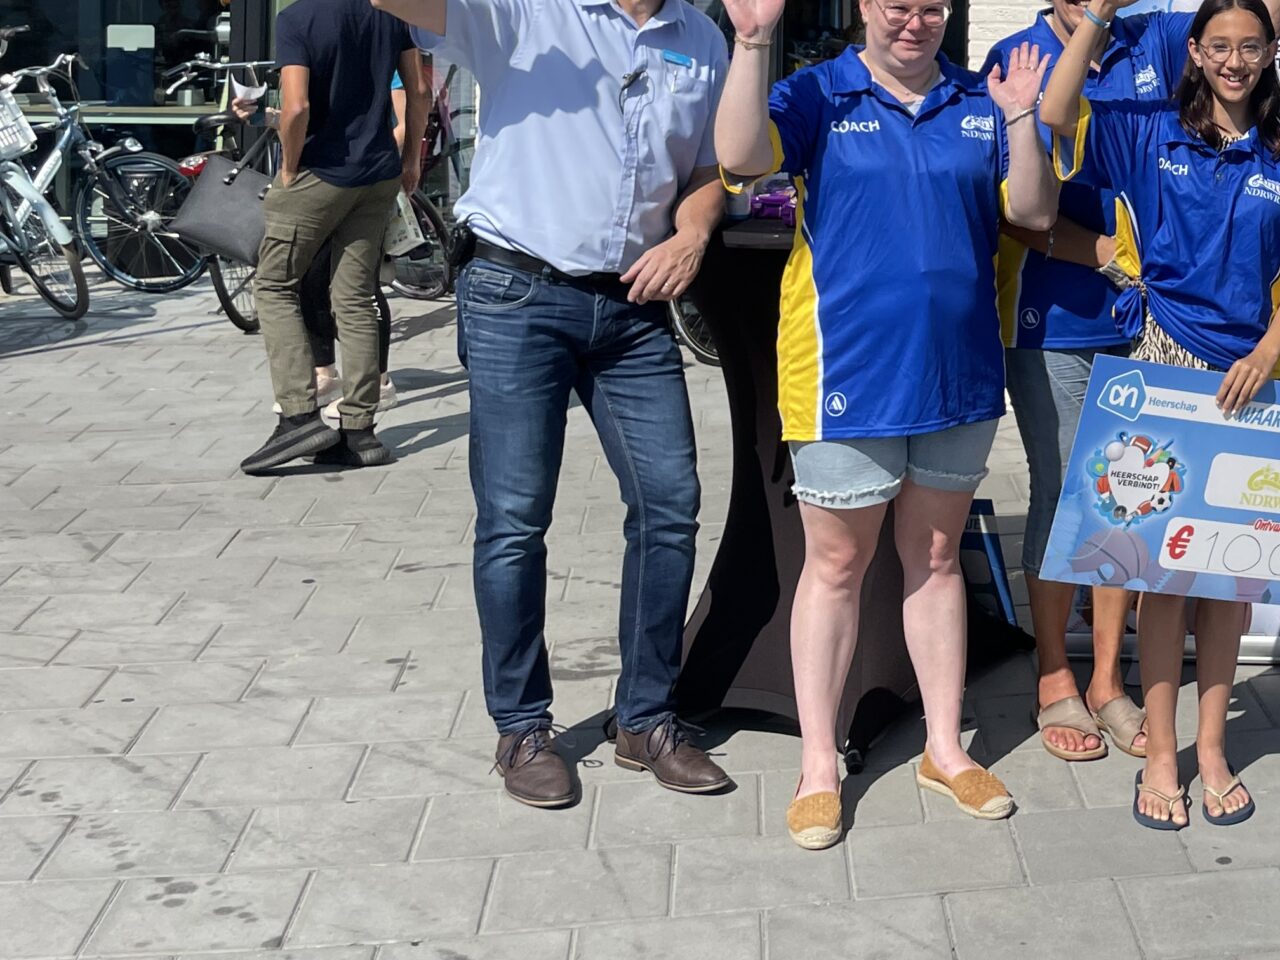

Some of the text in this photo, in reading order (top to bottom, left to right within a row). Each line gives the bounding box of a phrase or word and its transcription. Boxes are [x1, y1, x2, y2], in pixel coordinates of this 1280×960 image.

[830, 119, 881, 134] COACH
[1159, 157, 1188, 175] OACH
[1147, 396, 1198, 413] Heerschap
[1110, 470, 1159, 483] HEERSCHAP
[1166, 525, 1194, 560] €
